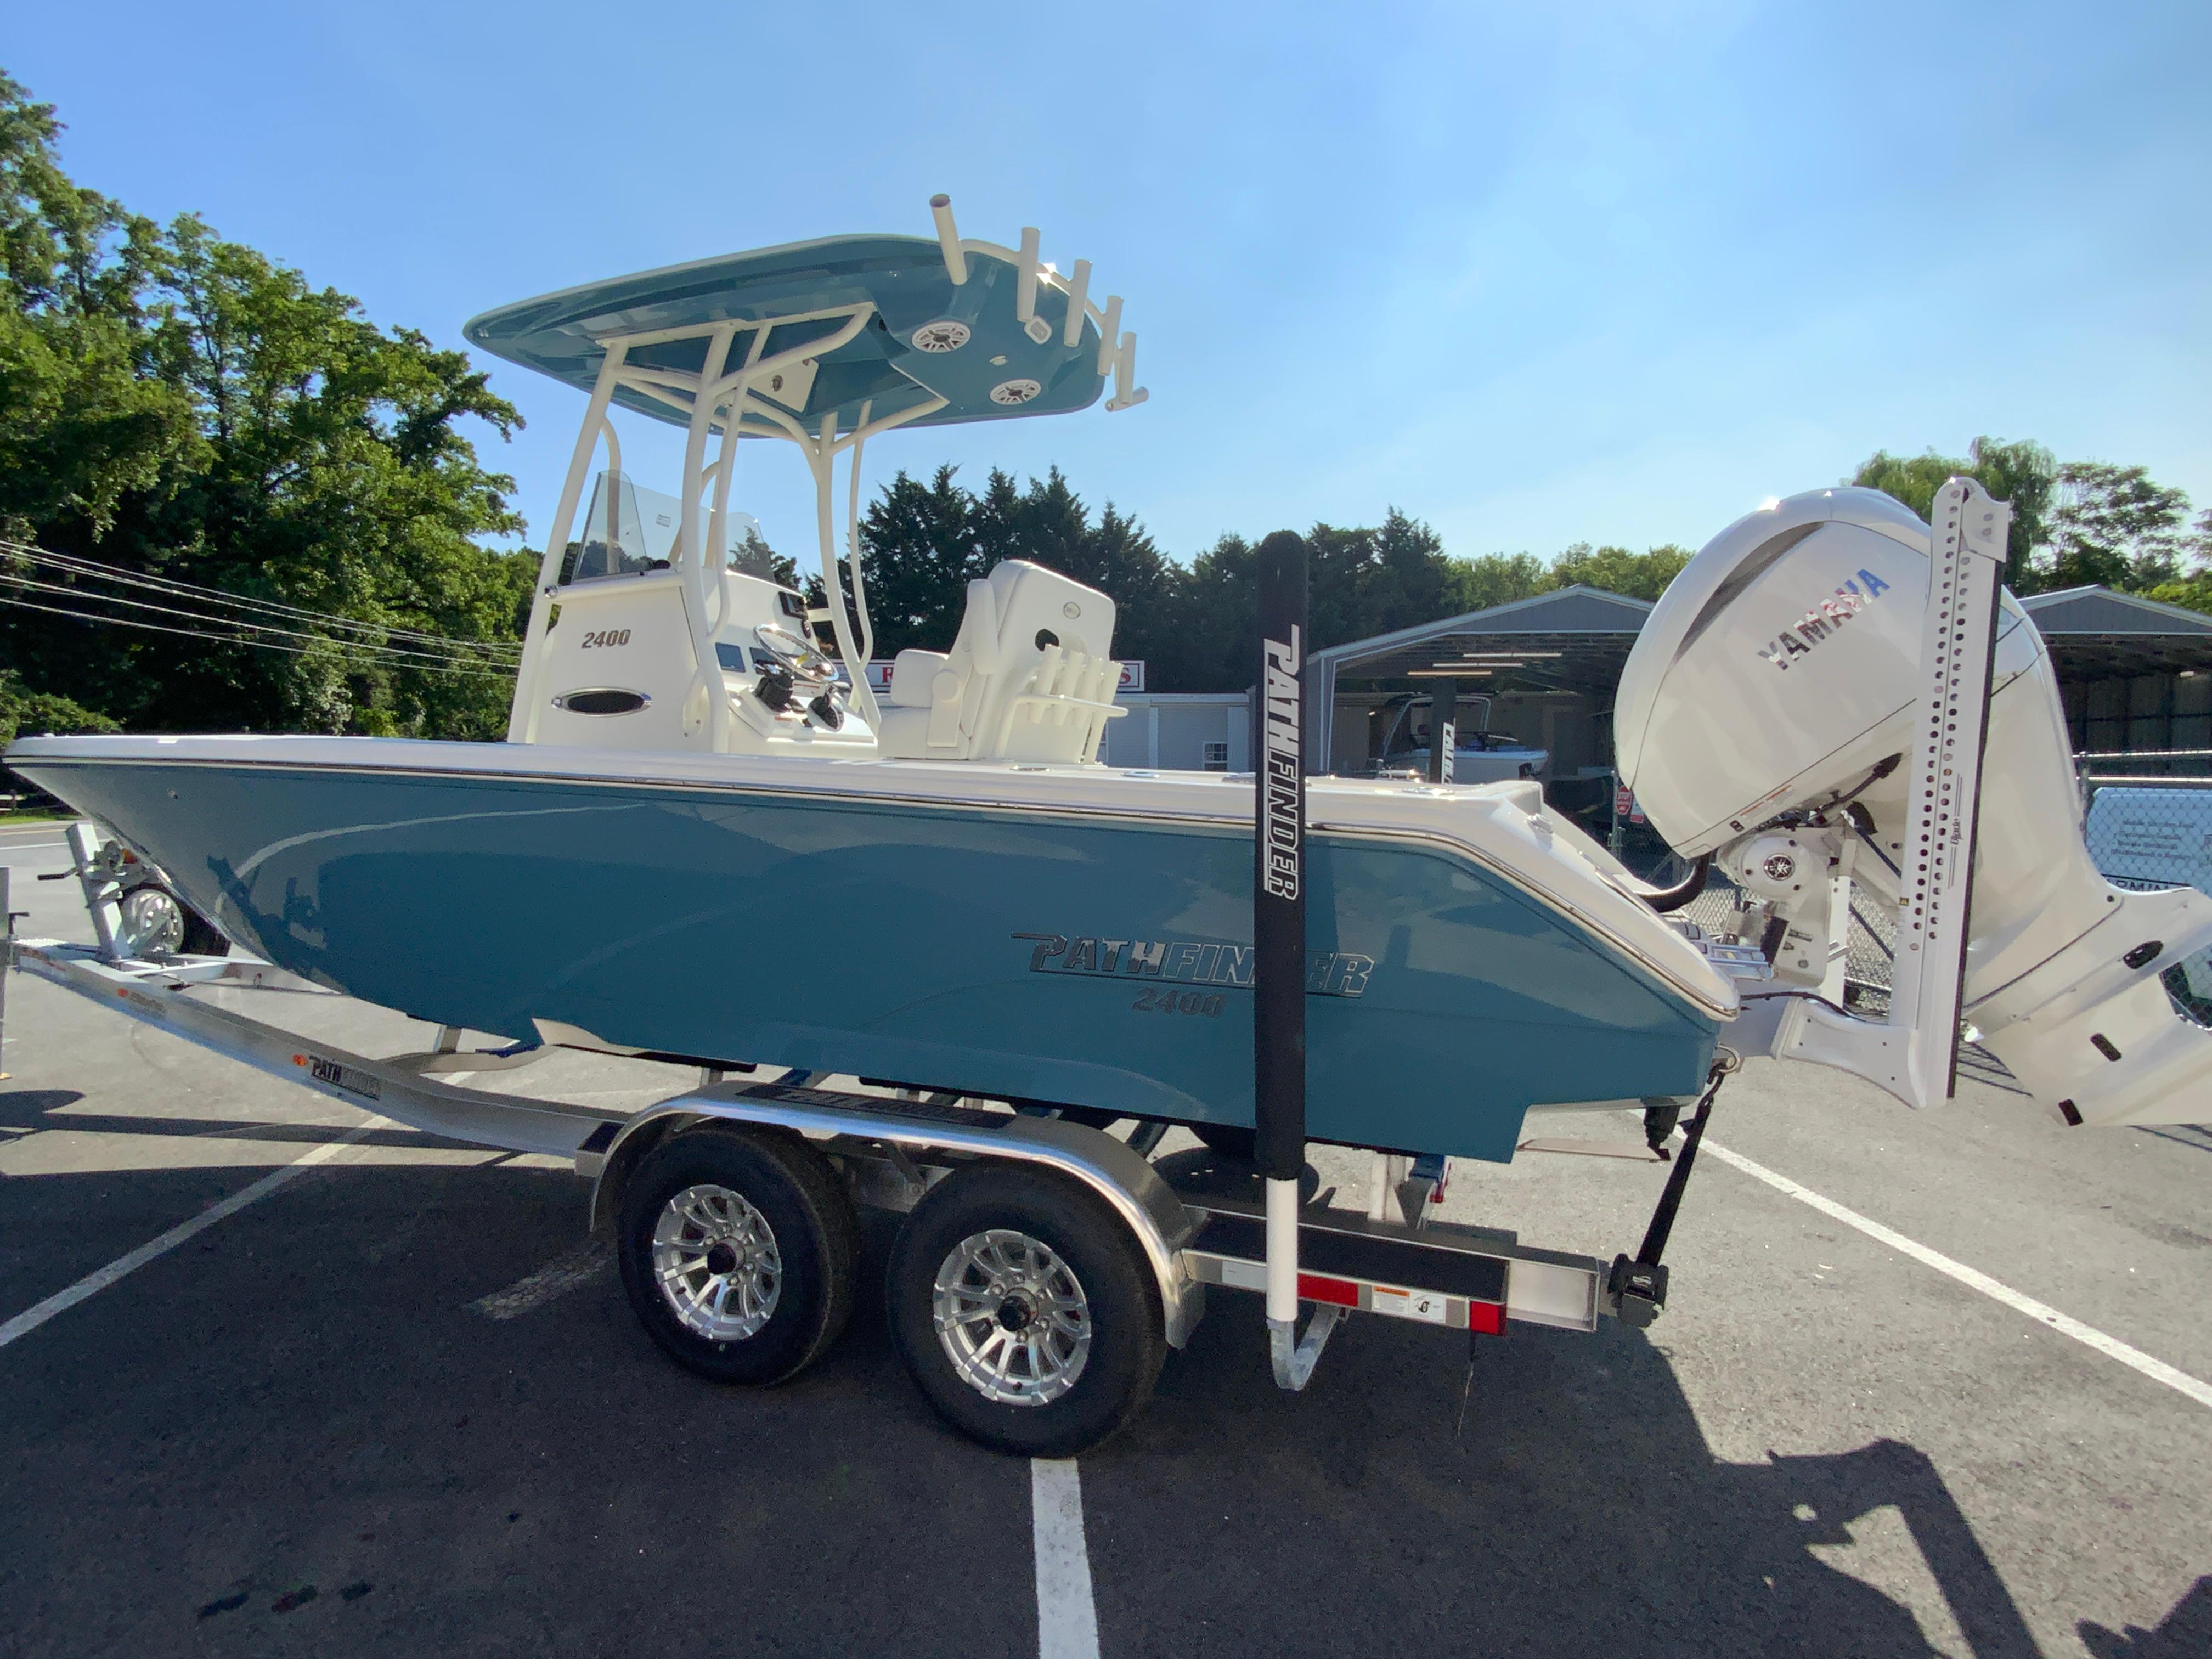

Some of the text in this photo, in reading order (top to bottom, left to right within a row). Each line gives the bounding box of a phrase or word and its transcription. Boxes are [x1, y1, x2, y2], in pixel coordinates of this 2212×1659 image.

[581, 629, 631, 649] 2400
[1757, 569, 1890, 670] YAMAHA
[1264, 624, 1300, 901] PATHFINDER
[1011, 932, 1375, 999] PATHFINER
[1132, 987, 1228, 1019] 2400
